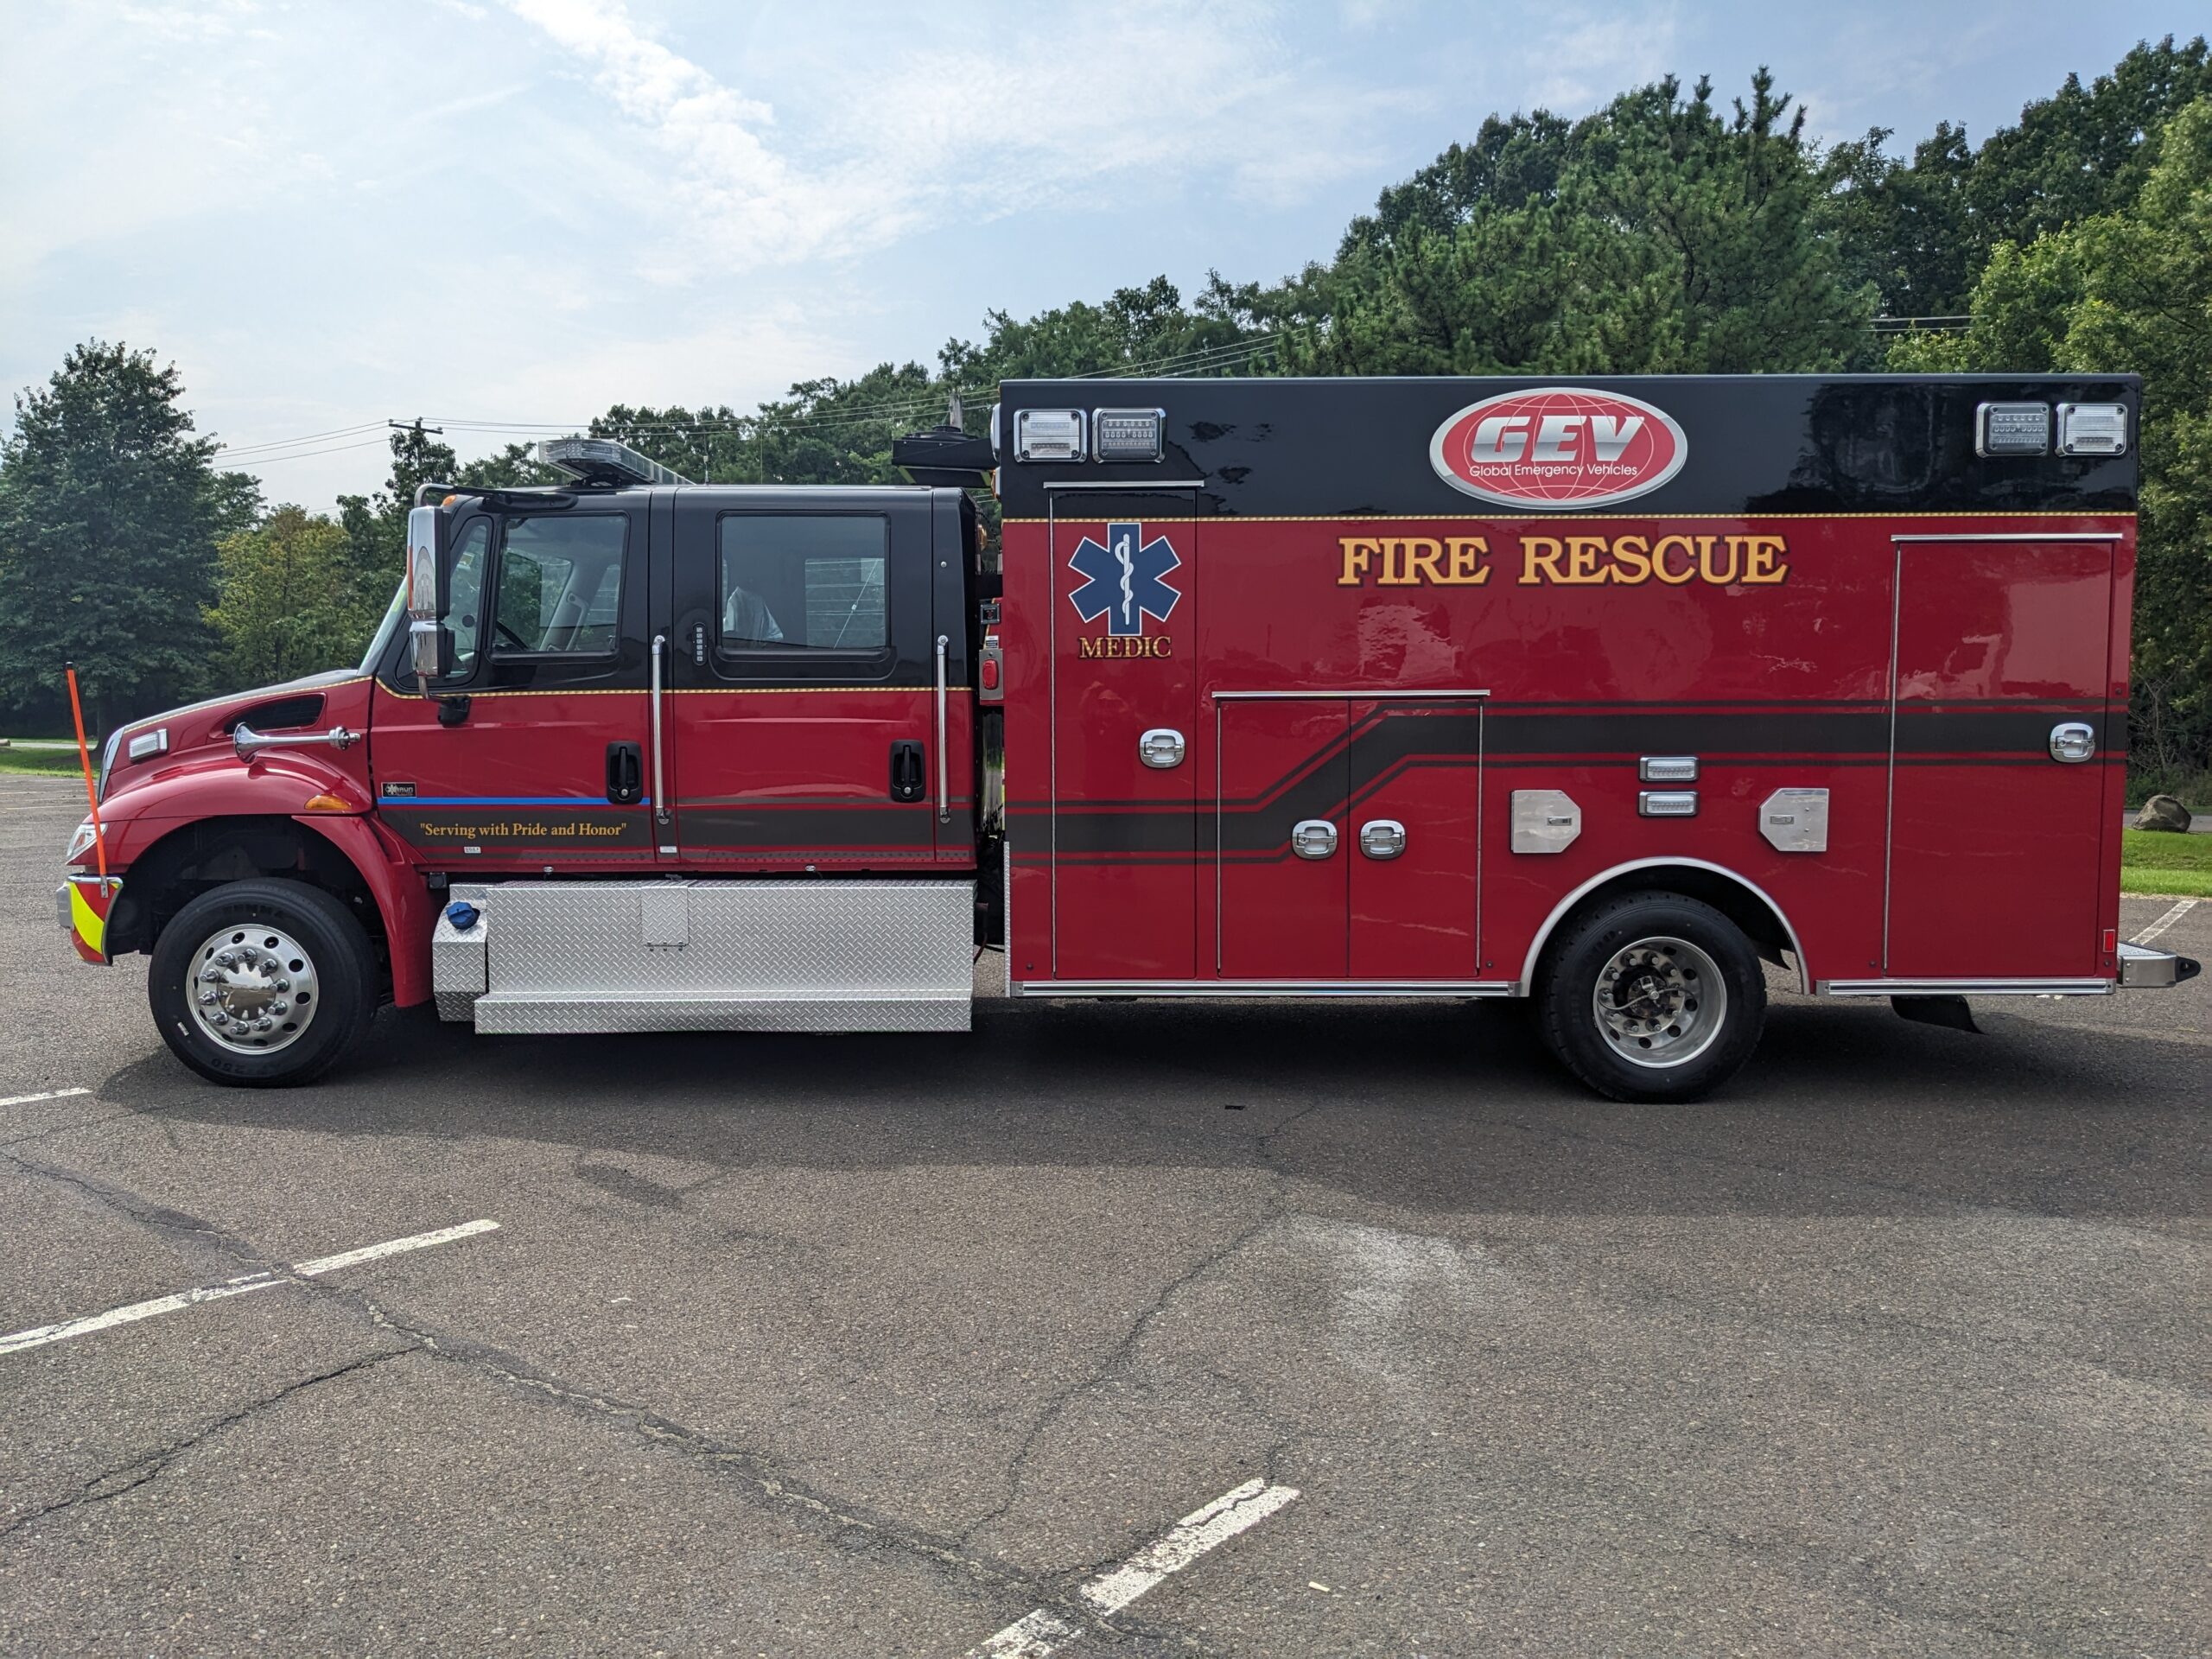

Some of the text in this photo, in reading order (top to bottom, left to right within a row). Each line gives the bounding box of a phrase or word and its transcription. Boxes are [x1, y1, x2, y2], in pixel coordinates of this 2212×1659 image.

[1471, 415, 1645, 463] GEV
[1470, 463, 1638, 478] Global Emergency Vehicles
[1336, 534, 1789, 586] FIRE RESCUE
[1078, 635, 1172, 658] MEDIC
[420, 823, 626, 839] "Serving with Pride and Honor"
